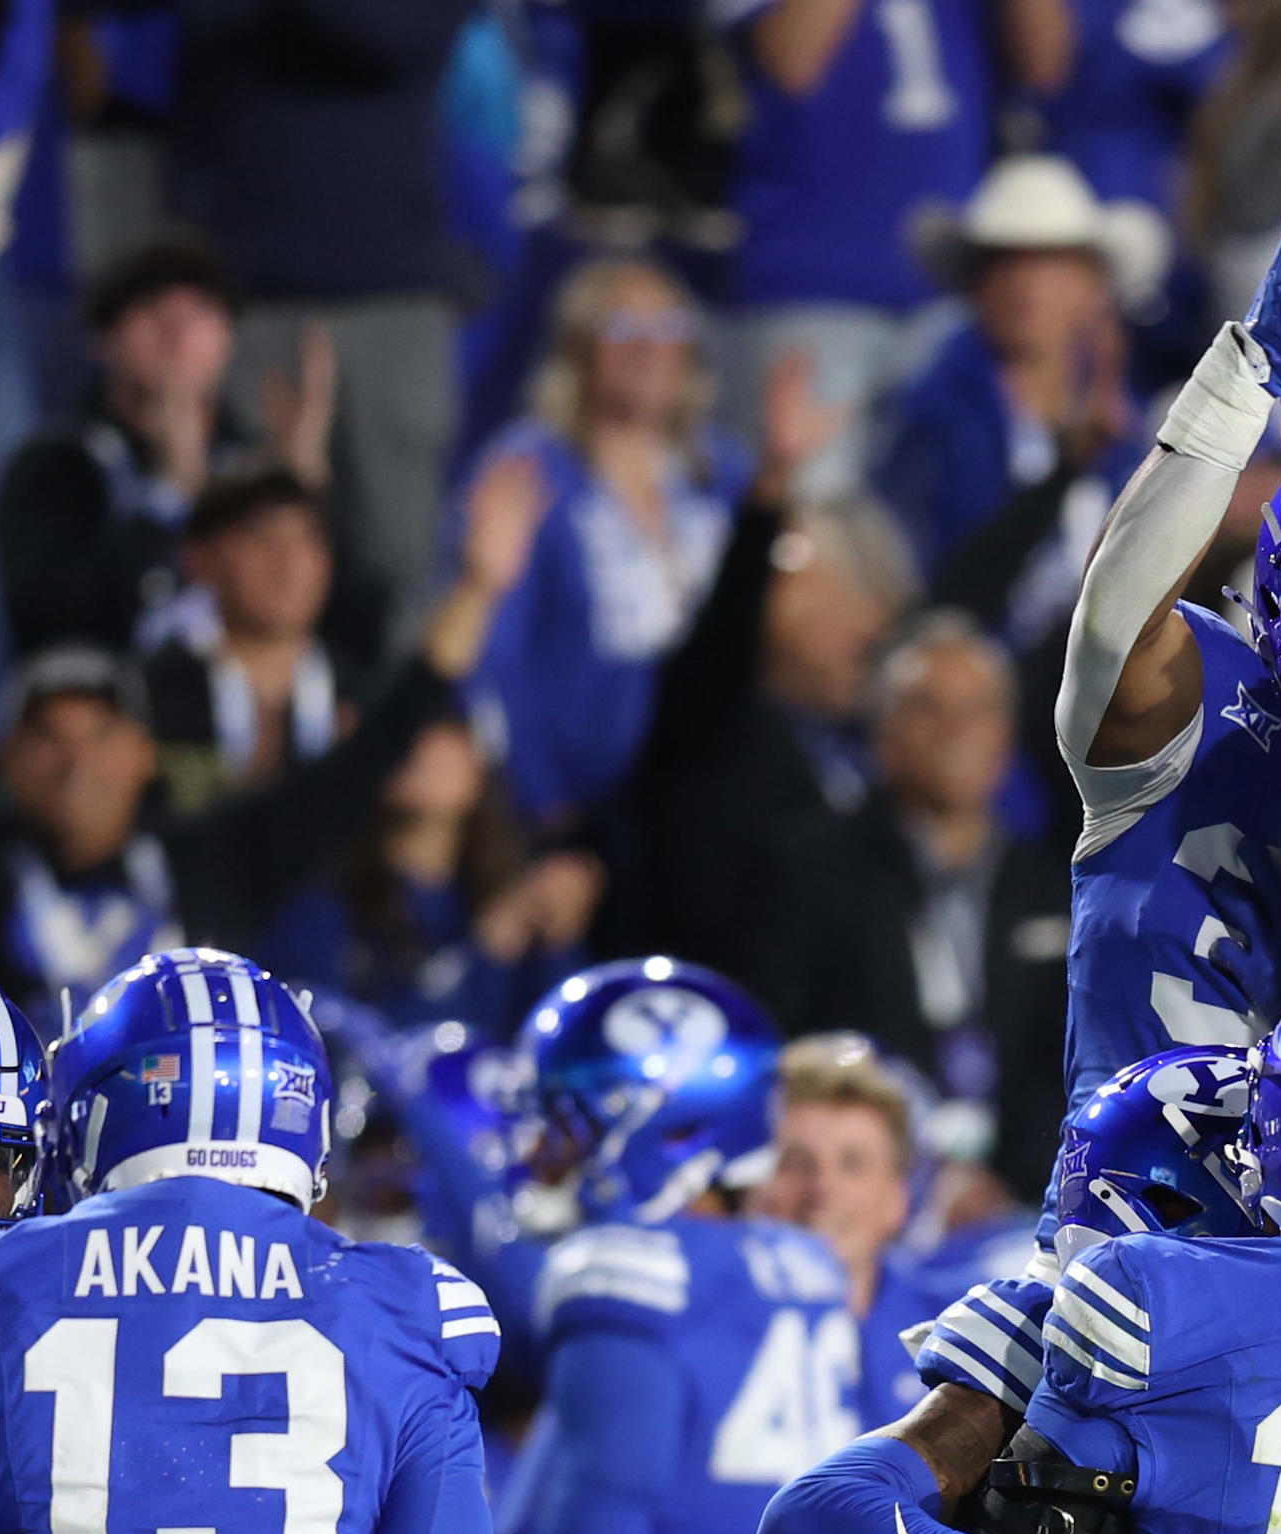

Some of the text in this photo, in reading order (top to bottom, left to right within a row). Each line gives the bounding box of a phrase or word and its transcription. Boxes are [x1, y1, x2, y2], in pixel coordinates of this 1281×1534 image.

[148, 1082, 173, 1106] 13
[1175, 1059, 1250, 1108] Y
[187, 1148, 258, 1168] GO COUGS
[74, 1224, 305, 1300] AKANA
